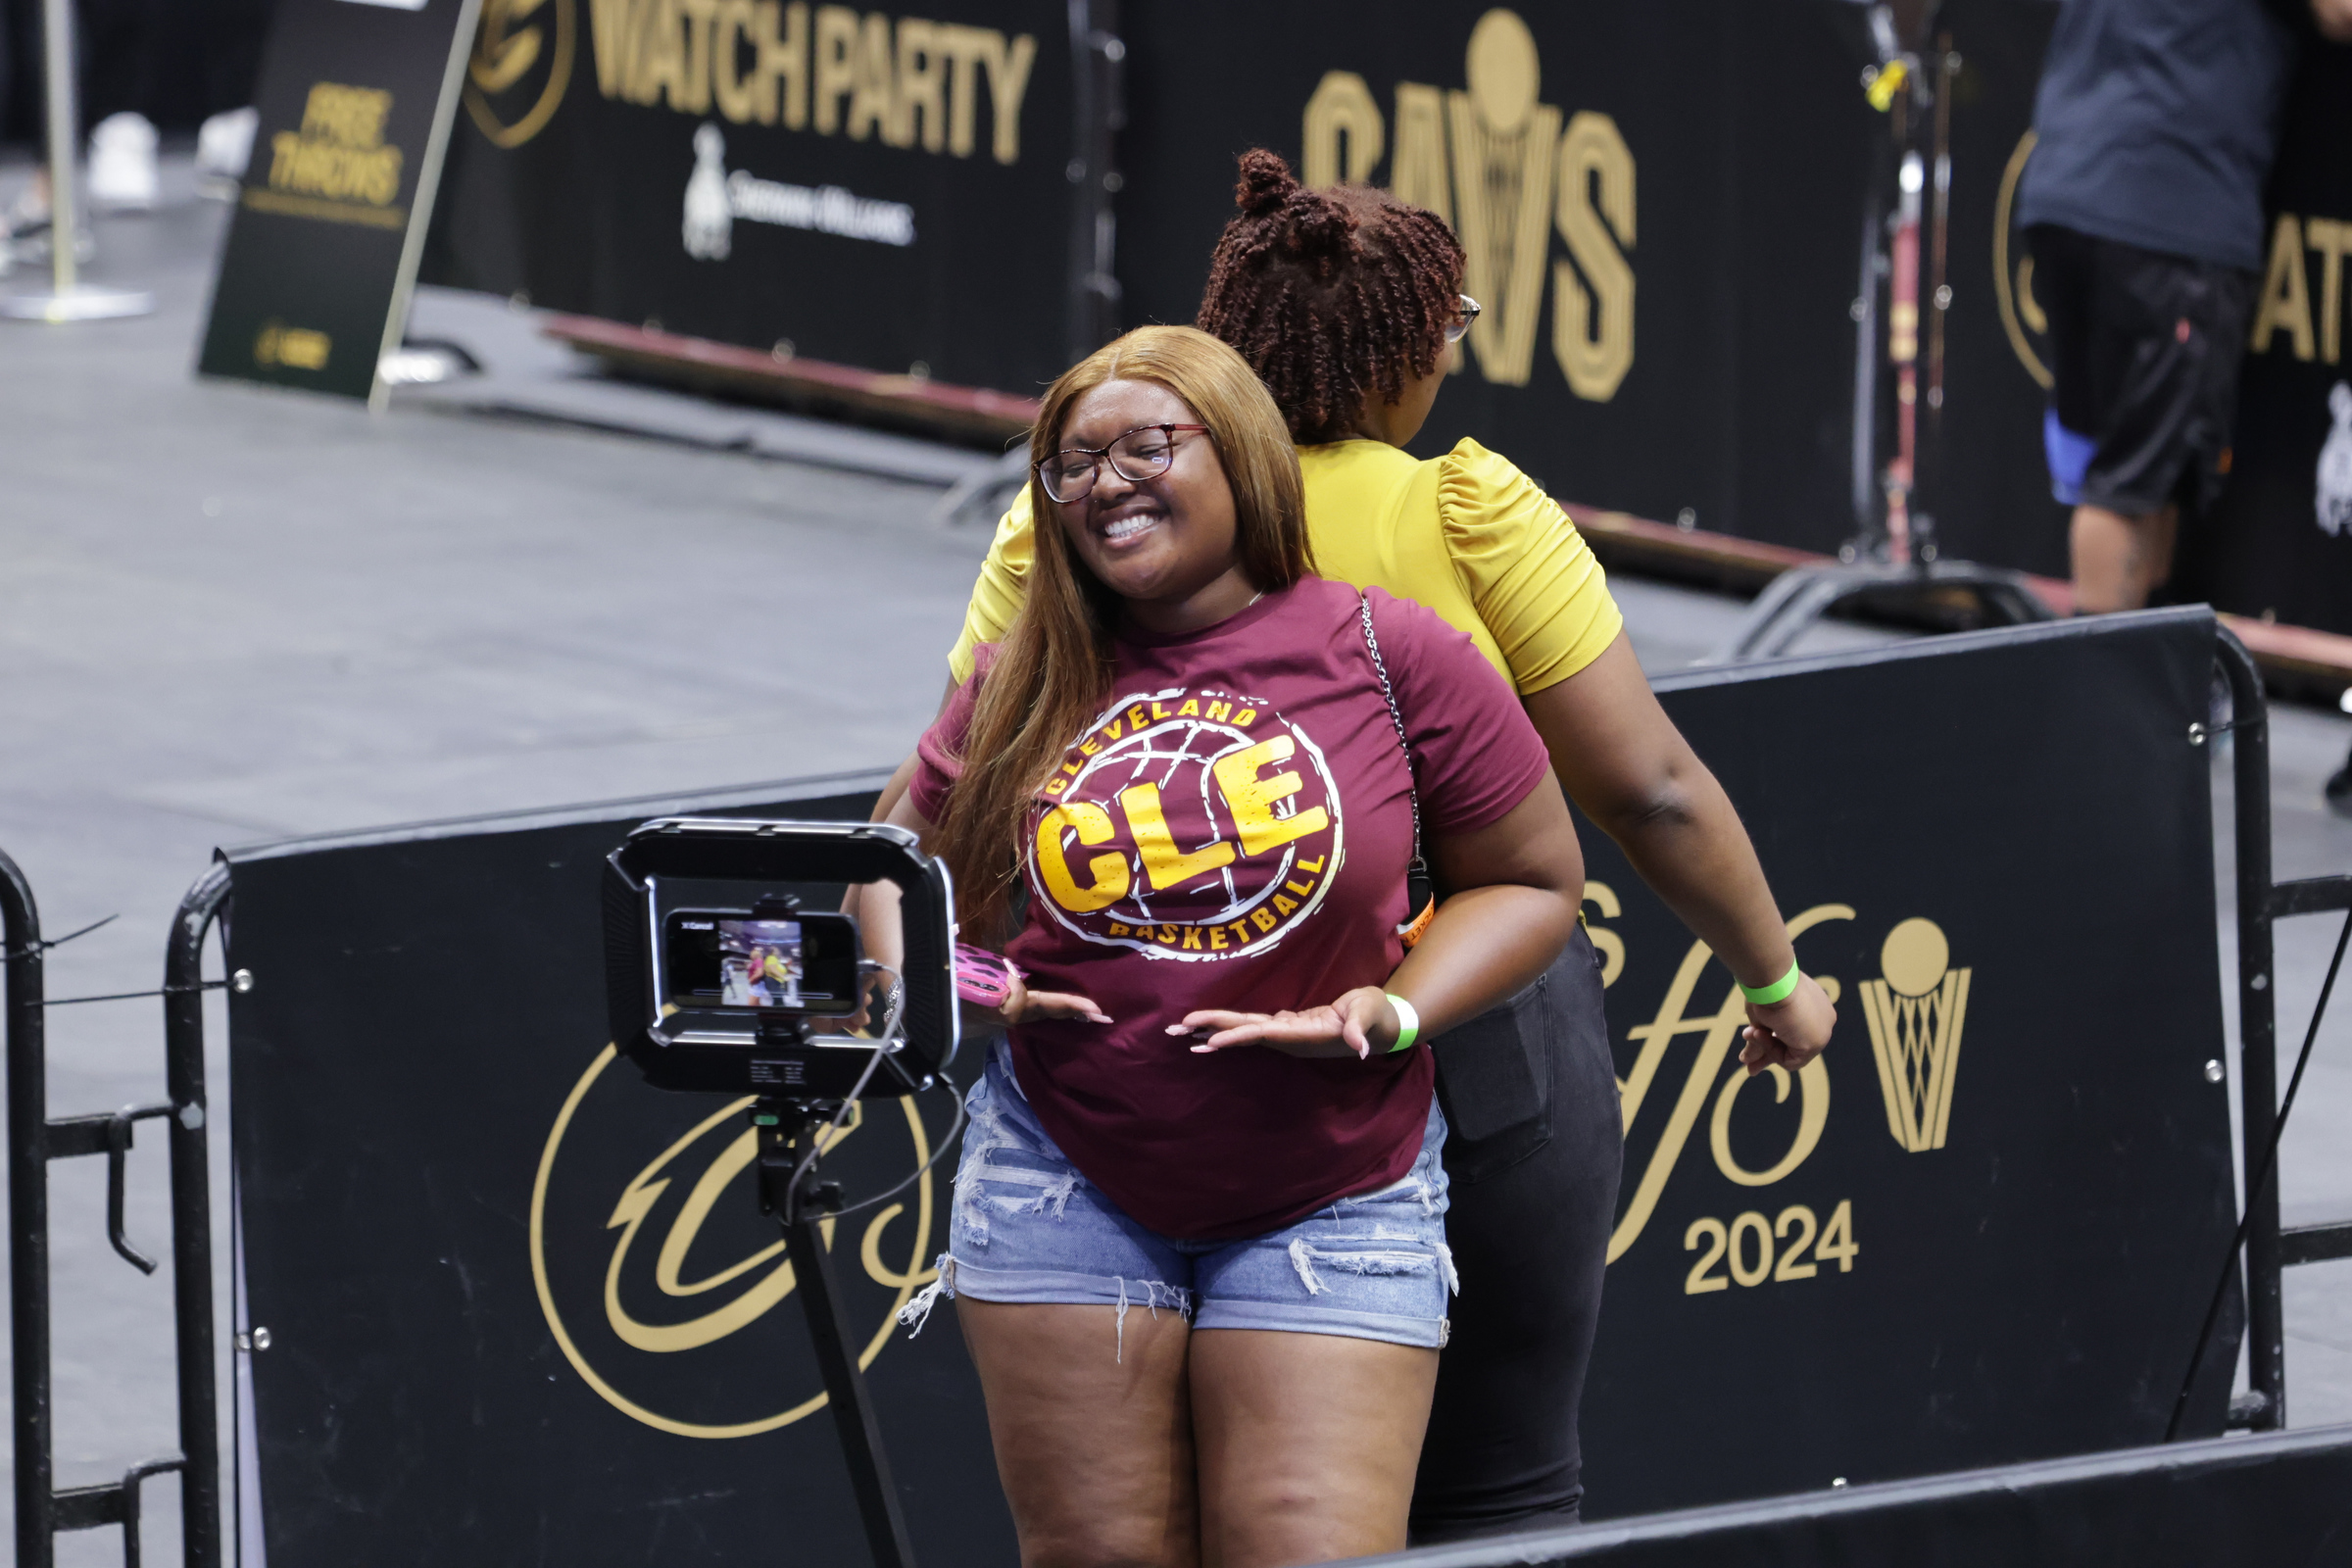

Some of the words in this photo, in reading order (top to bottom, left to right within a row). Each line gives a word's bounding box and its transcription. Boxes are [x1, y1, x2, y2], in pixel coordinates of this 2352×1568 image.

[590, 0, 811, 131] WATCH
[812, 5, 1038, 165] PARTY
[1045, 699, 1257, 796] CLEVELAND
[1036, 734, 1329, 912] CLE
[1108, 855, 1325, 951] BASKETBALL
[1684, 1199, 1860, 1296] 2024
